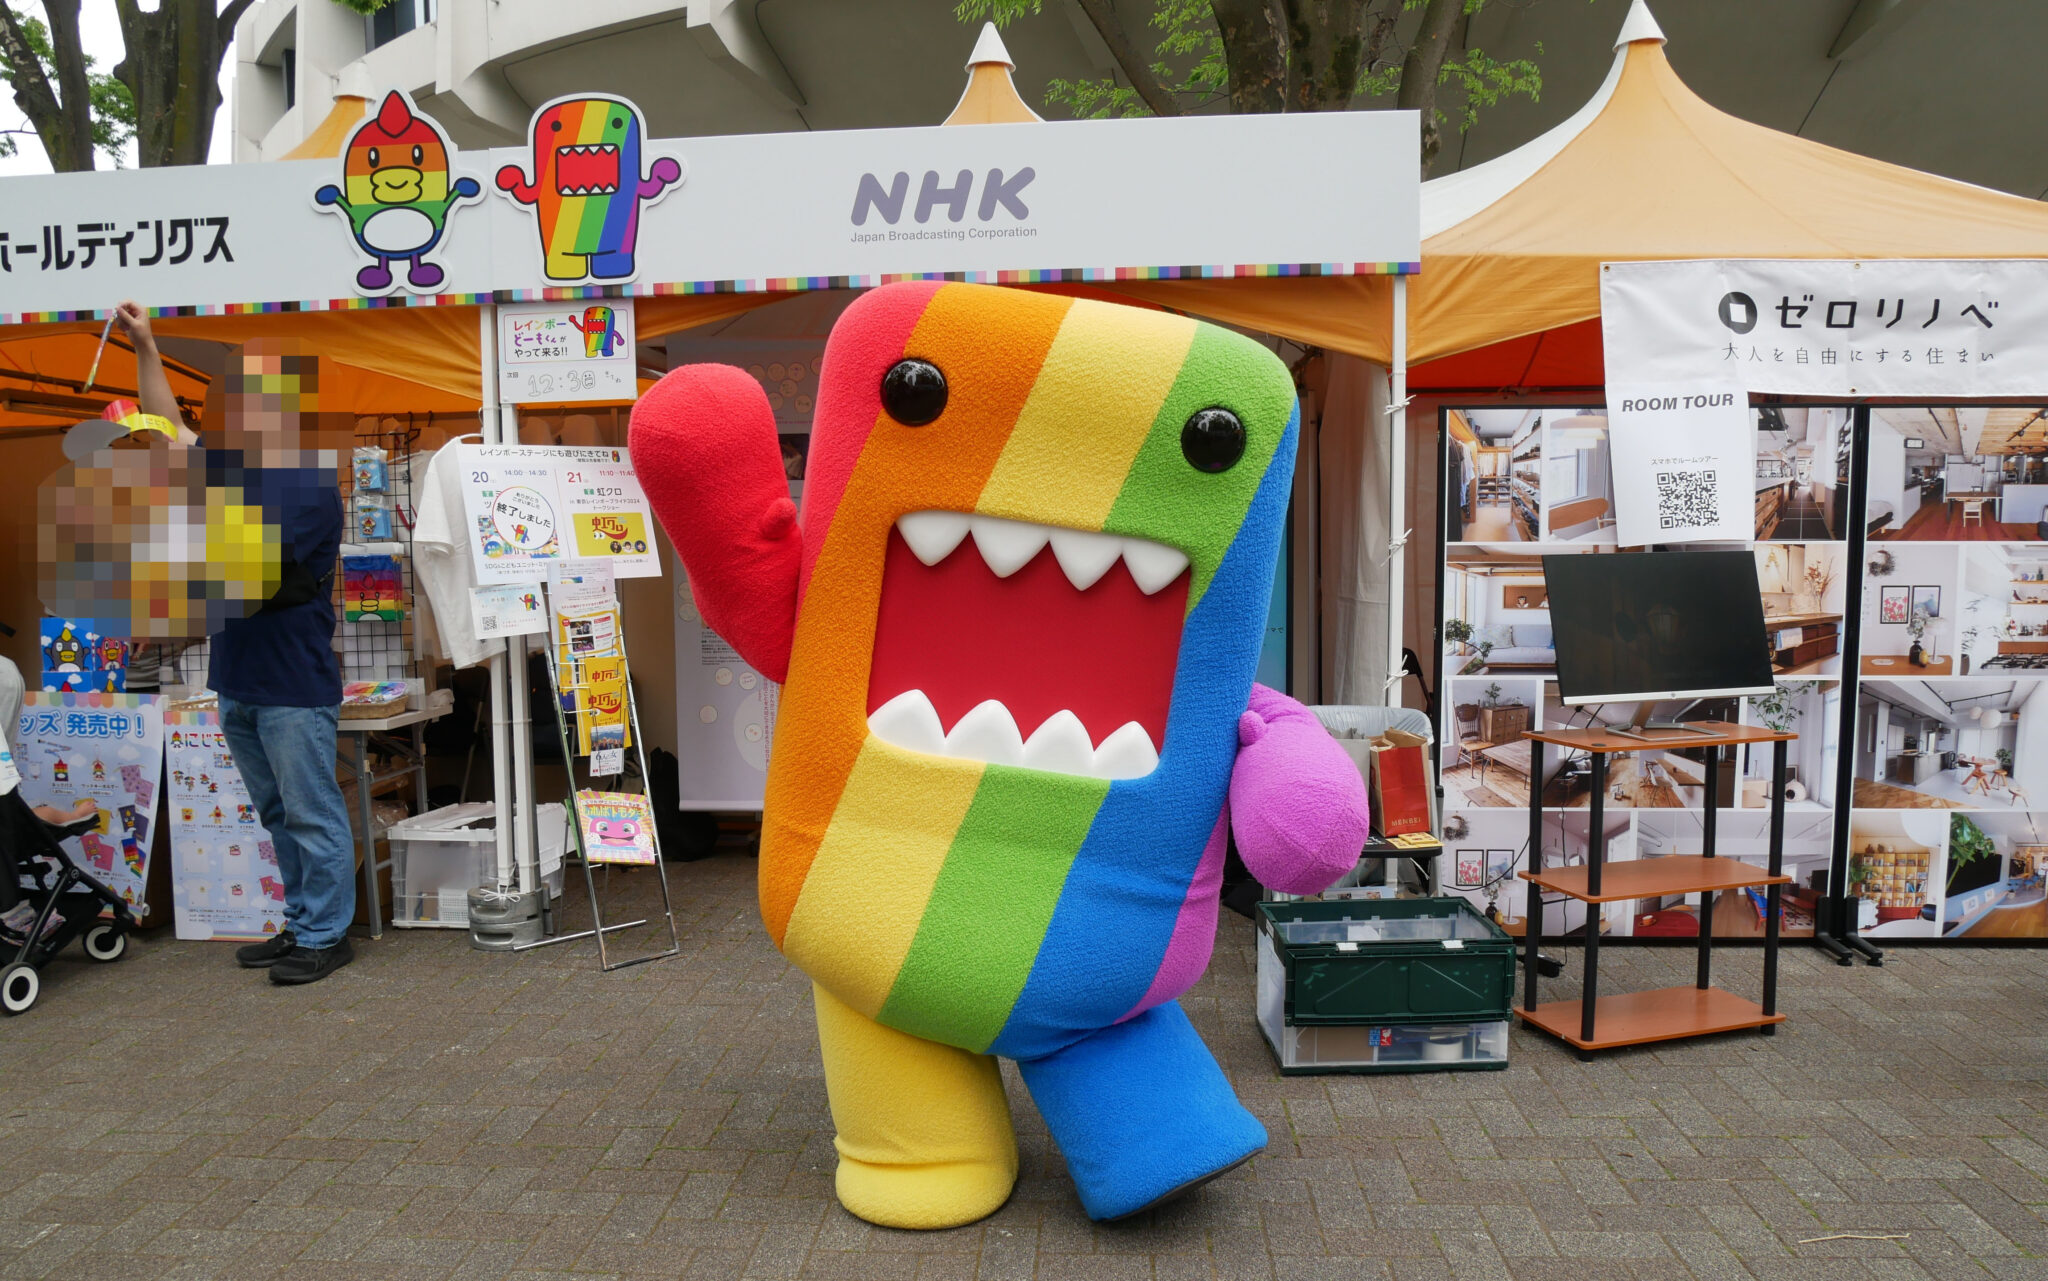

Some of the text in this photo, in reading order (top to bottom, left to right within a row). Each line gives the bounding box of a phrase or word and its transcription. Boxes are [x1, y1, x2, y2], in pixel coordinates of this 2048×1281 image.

[850, 166, 1036, 226] NHK
[850, 227, 1037, 245] Japan Broadcasting Corporation
[1774, 294, 1999, 329] ゼロリノベ
[514, 318, 567, 331] レインボー
[1721, 341, 1995, 366] 大人を自由にする住まい
[1621, 392, 1735, 413] ROOM TOUR
[479, 448, 609, 458] レインボーステージにも遊びにきてね
[1650, 455, 1719, 466] スマホでルームツアー
[471, 471, 489, 483] 20
[567, 471, 583, 483] 21
[596, 487, 622, 496] 虹クロ
[496, 502, 551, 528] 終了しました
